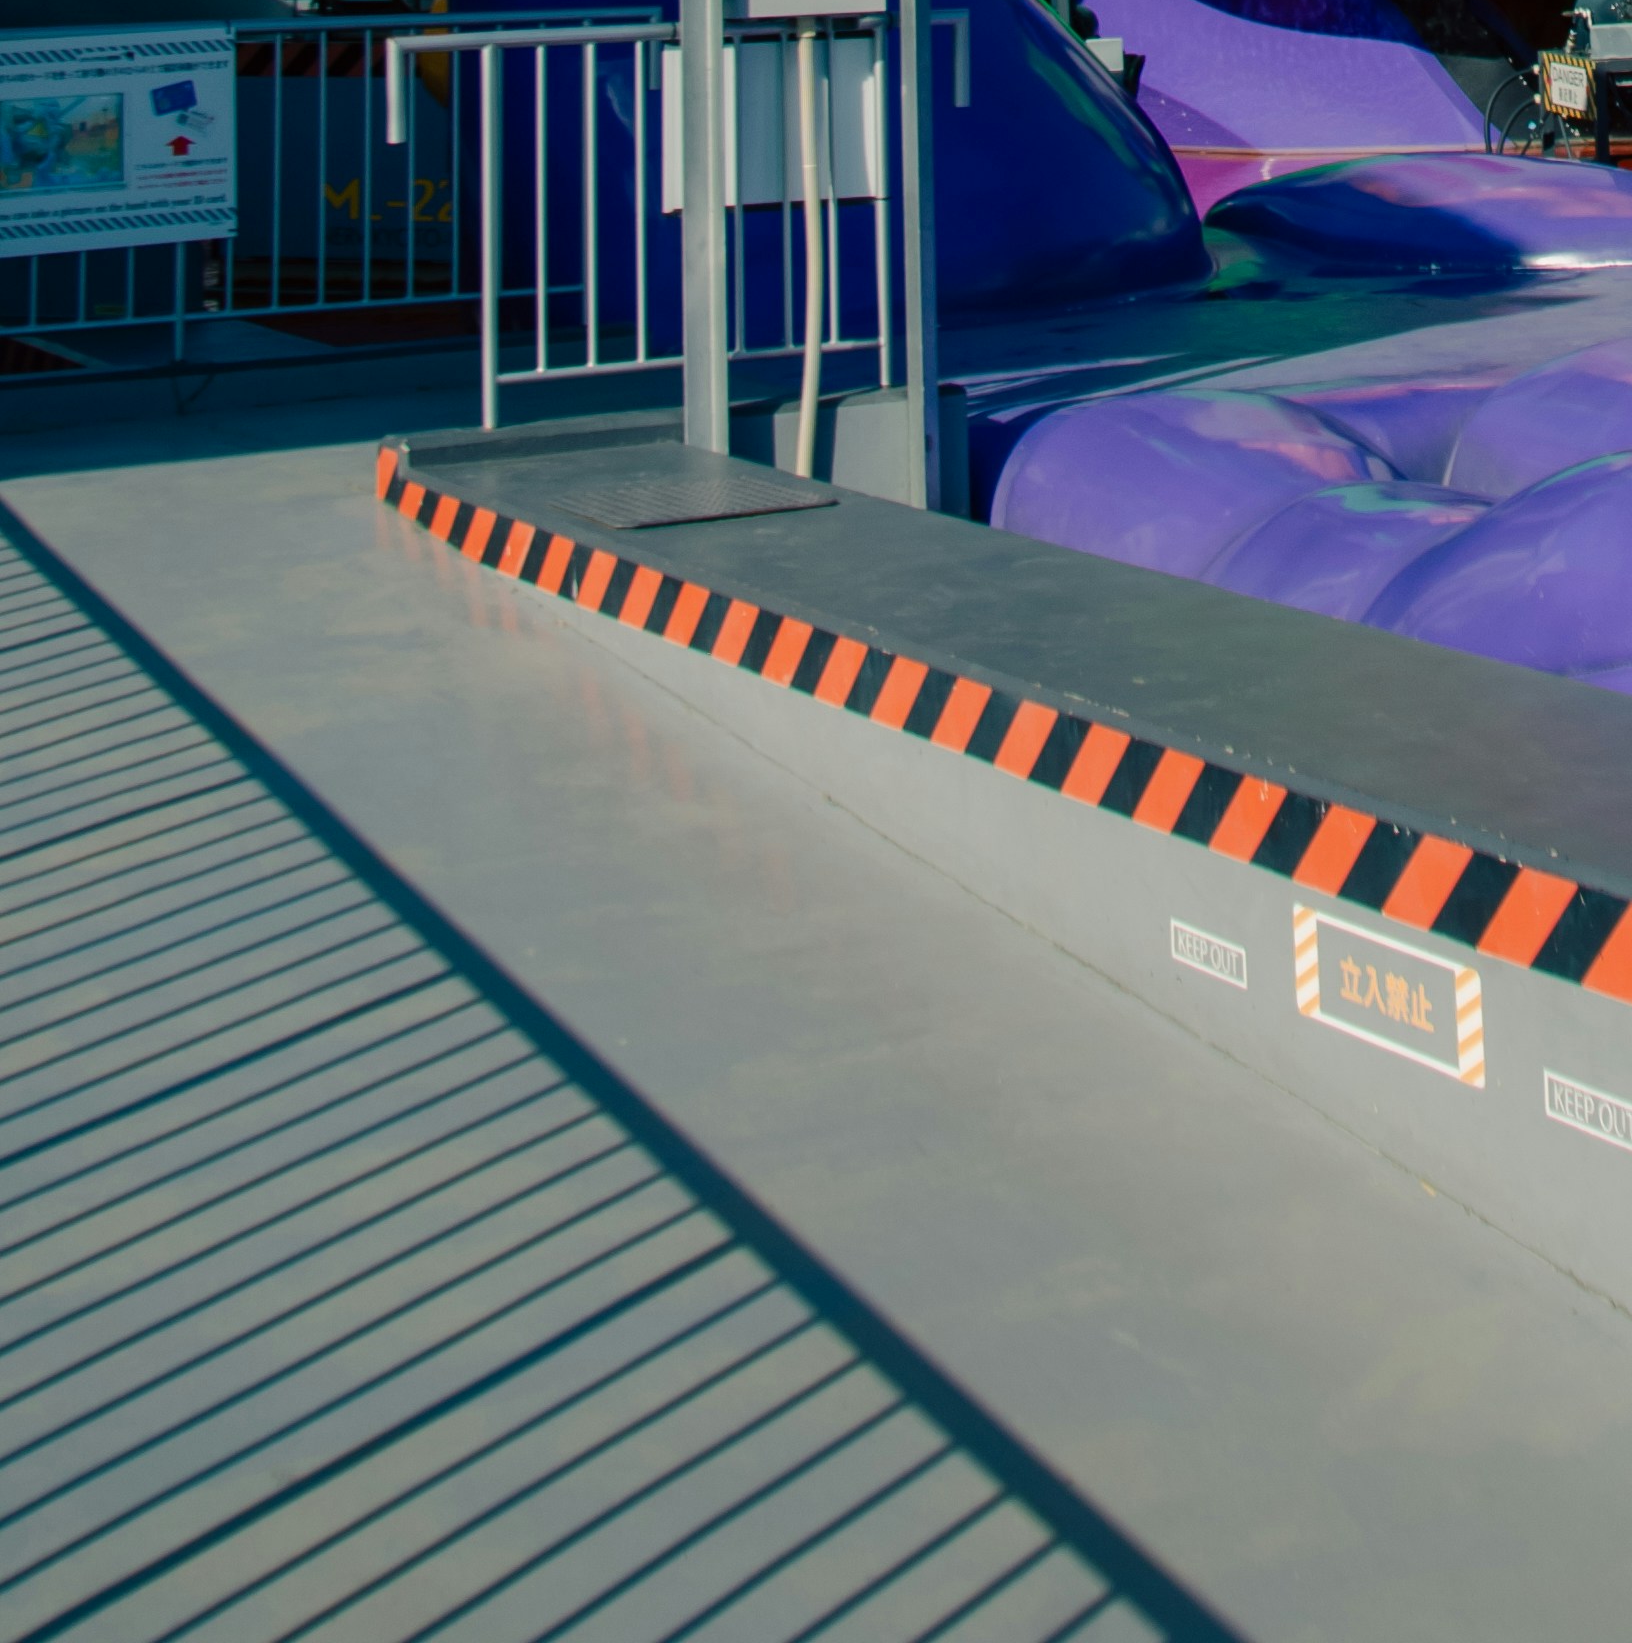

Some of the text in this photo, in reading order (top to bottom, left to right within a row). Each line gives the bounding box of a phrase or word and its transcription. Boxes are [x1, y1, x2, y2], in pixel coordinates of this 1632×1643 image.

[1552, 66, 1584, 88] DANGER
[1177, 929, 1239, 976] KEEP OUT
[1339, 954, 1435, 1034] 立入禁止
[1553, 1080, 1596, 1124] KEEP
